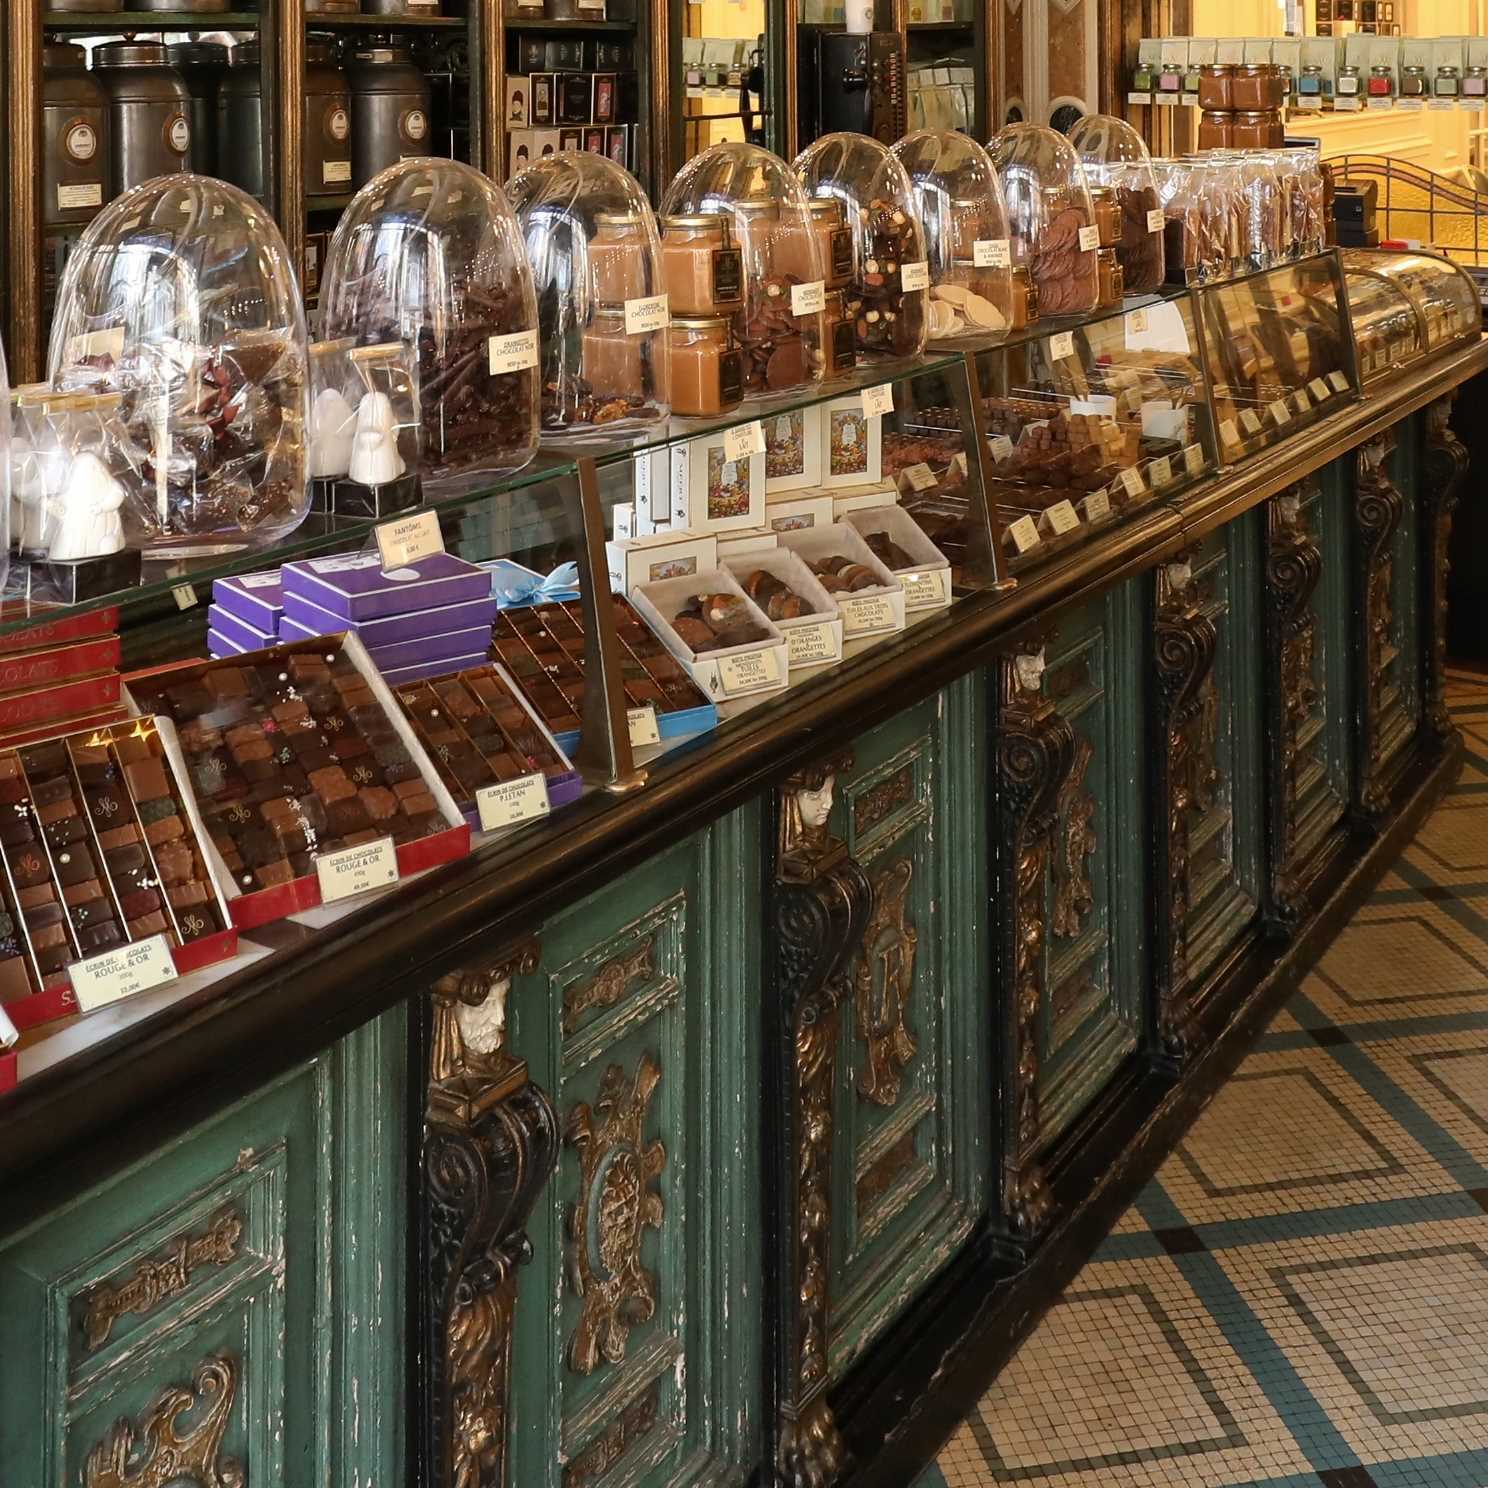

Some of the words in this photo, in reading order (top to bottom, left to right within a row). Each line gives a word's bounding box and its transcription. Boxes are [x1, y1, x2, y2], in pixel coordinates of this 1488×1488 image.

[336, 860, 361, 872] ROUGE
[369, 855, 379, 864] OR
[94, 963, 126, 979] ROUGE
[128, 960, 135, 968] &
[136, 953, 150, 964] OR
